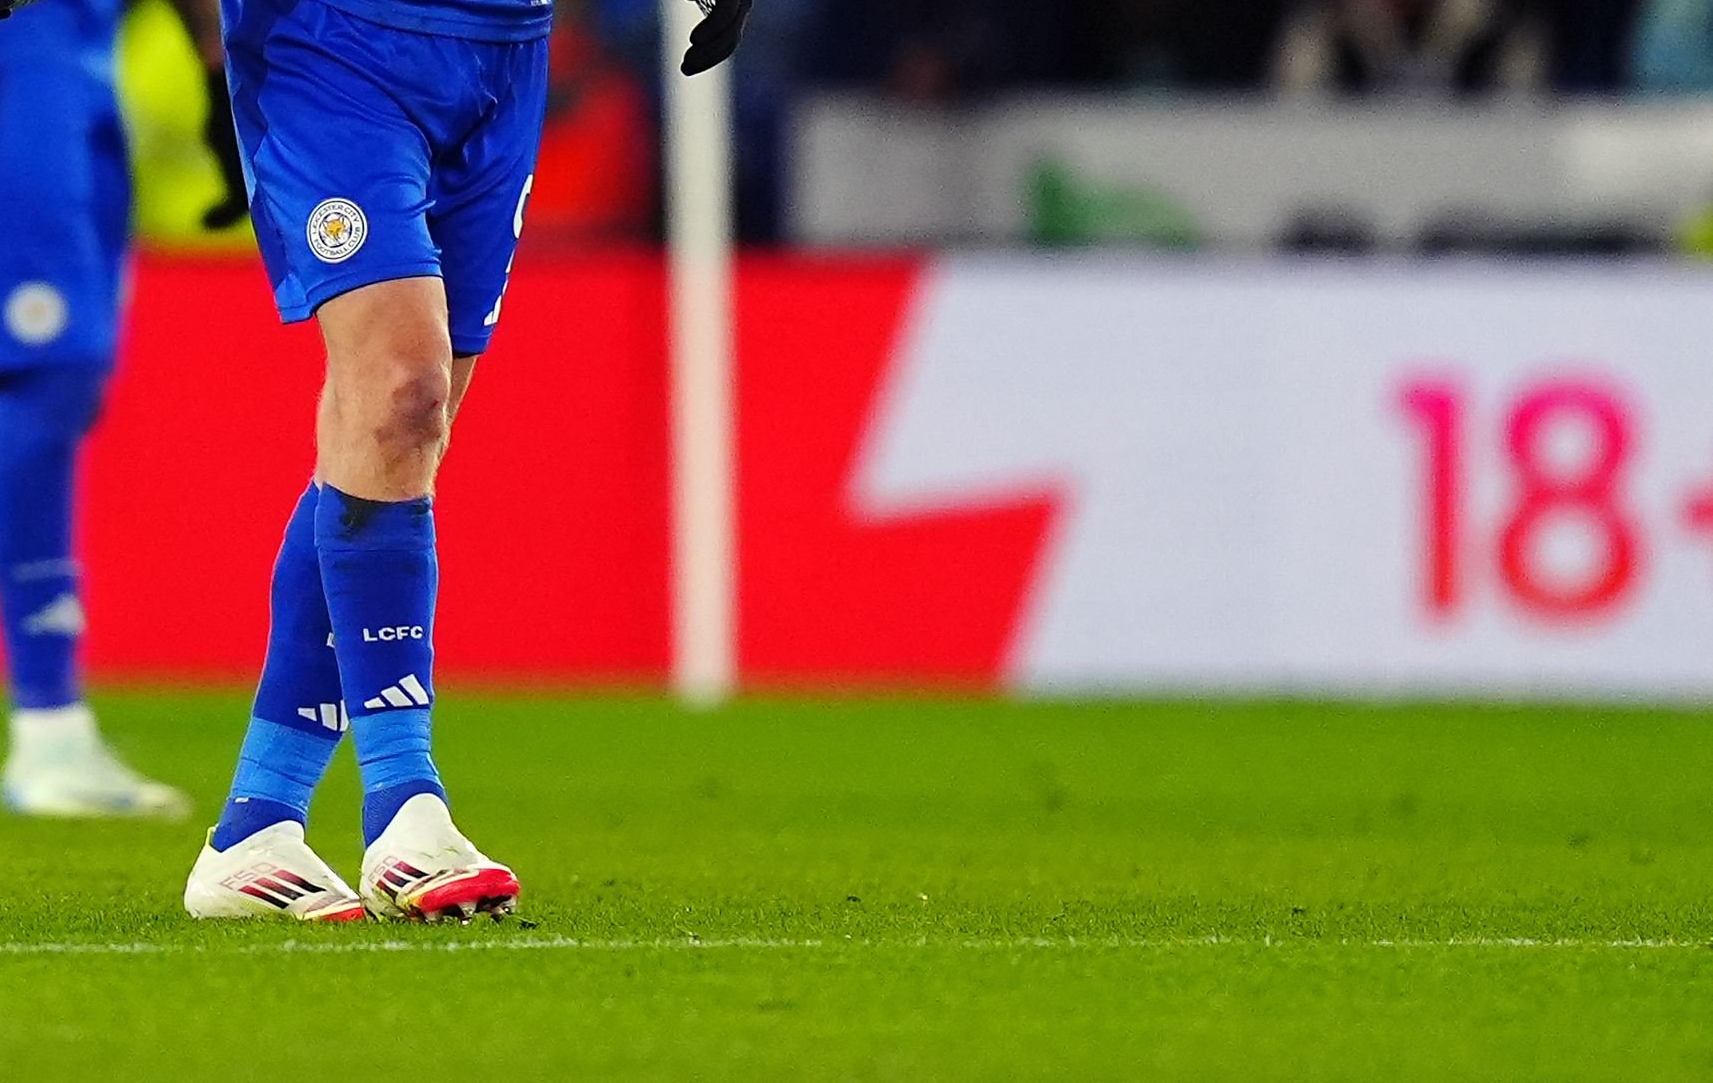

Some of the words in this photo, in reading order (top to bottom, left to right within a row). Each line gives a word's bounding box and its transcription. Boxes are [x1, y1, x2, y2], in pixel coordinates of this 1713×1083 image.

[343, 207, 360, 223] CITY
[348, 226, 361, 248] CLUB
[362, 625, 424, 643] LCFC
